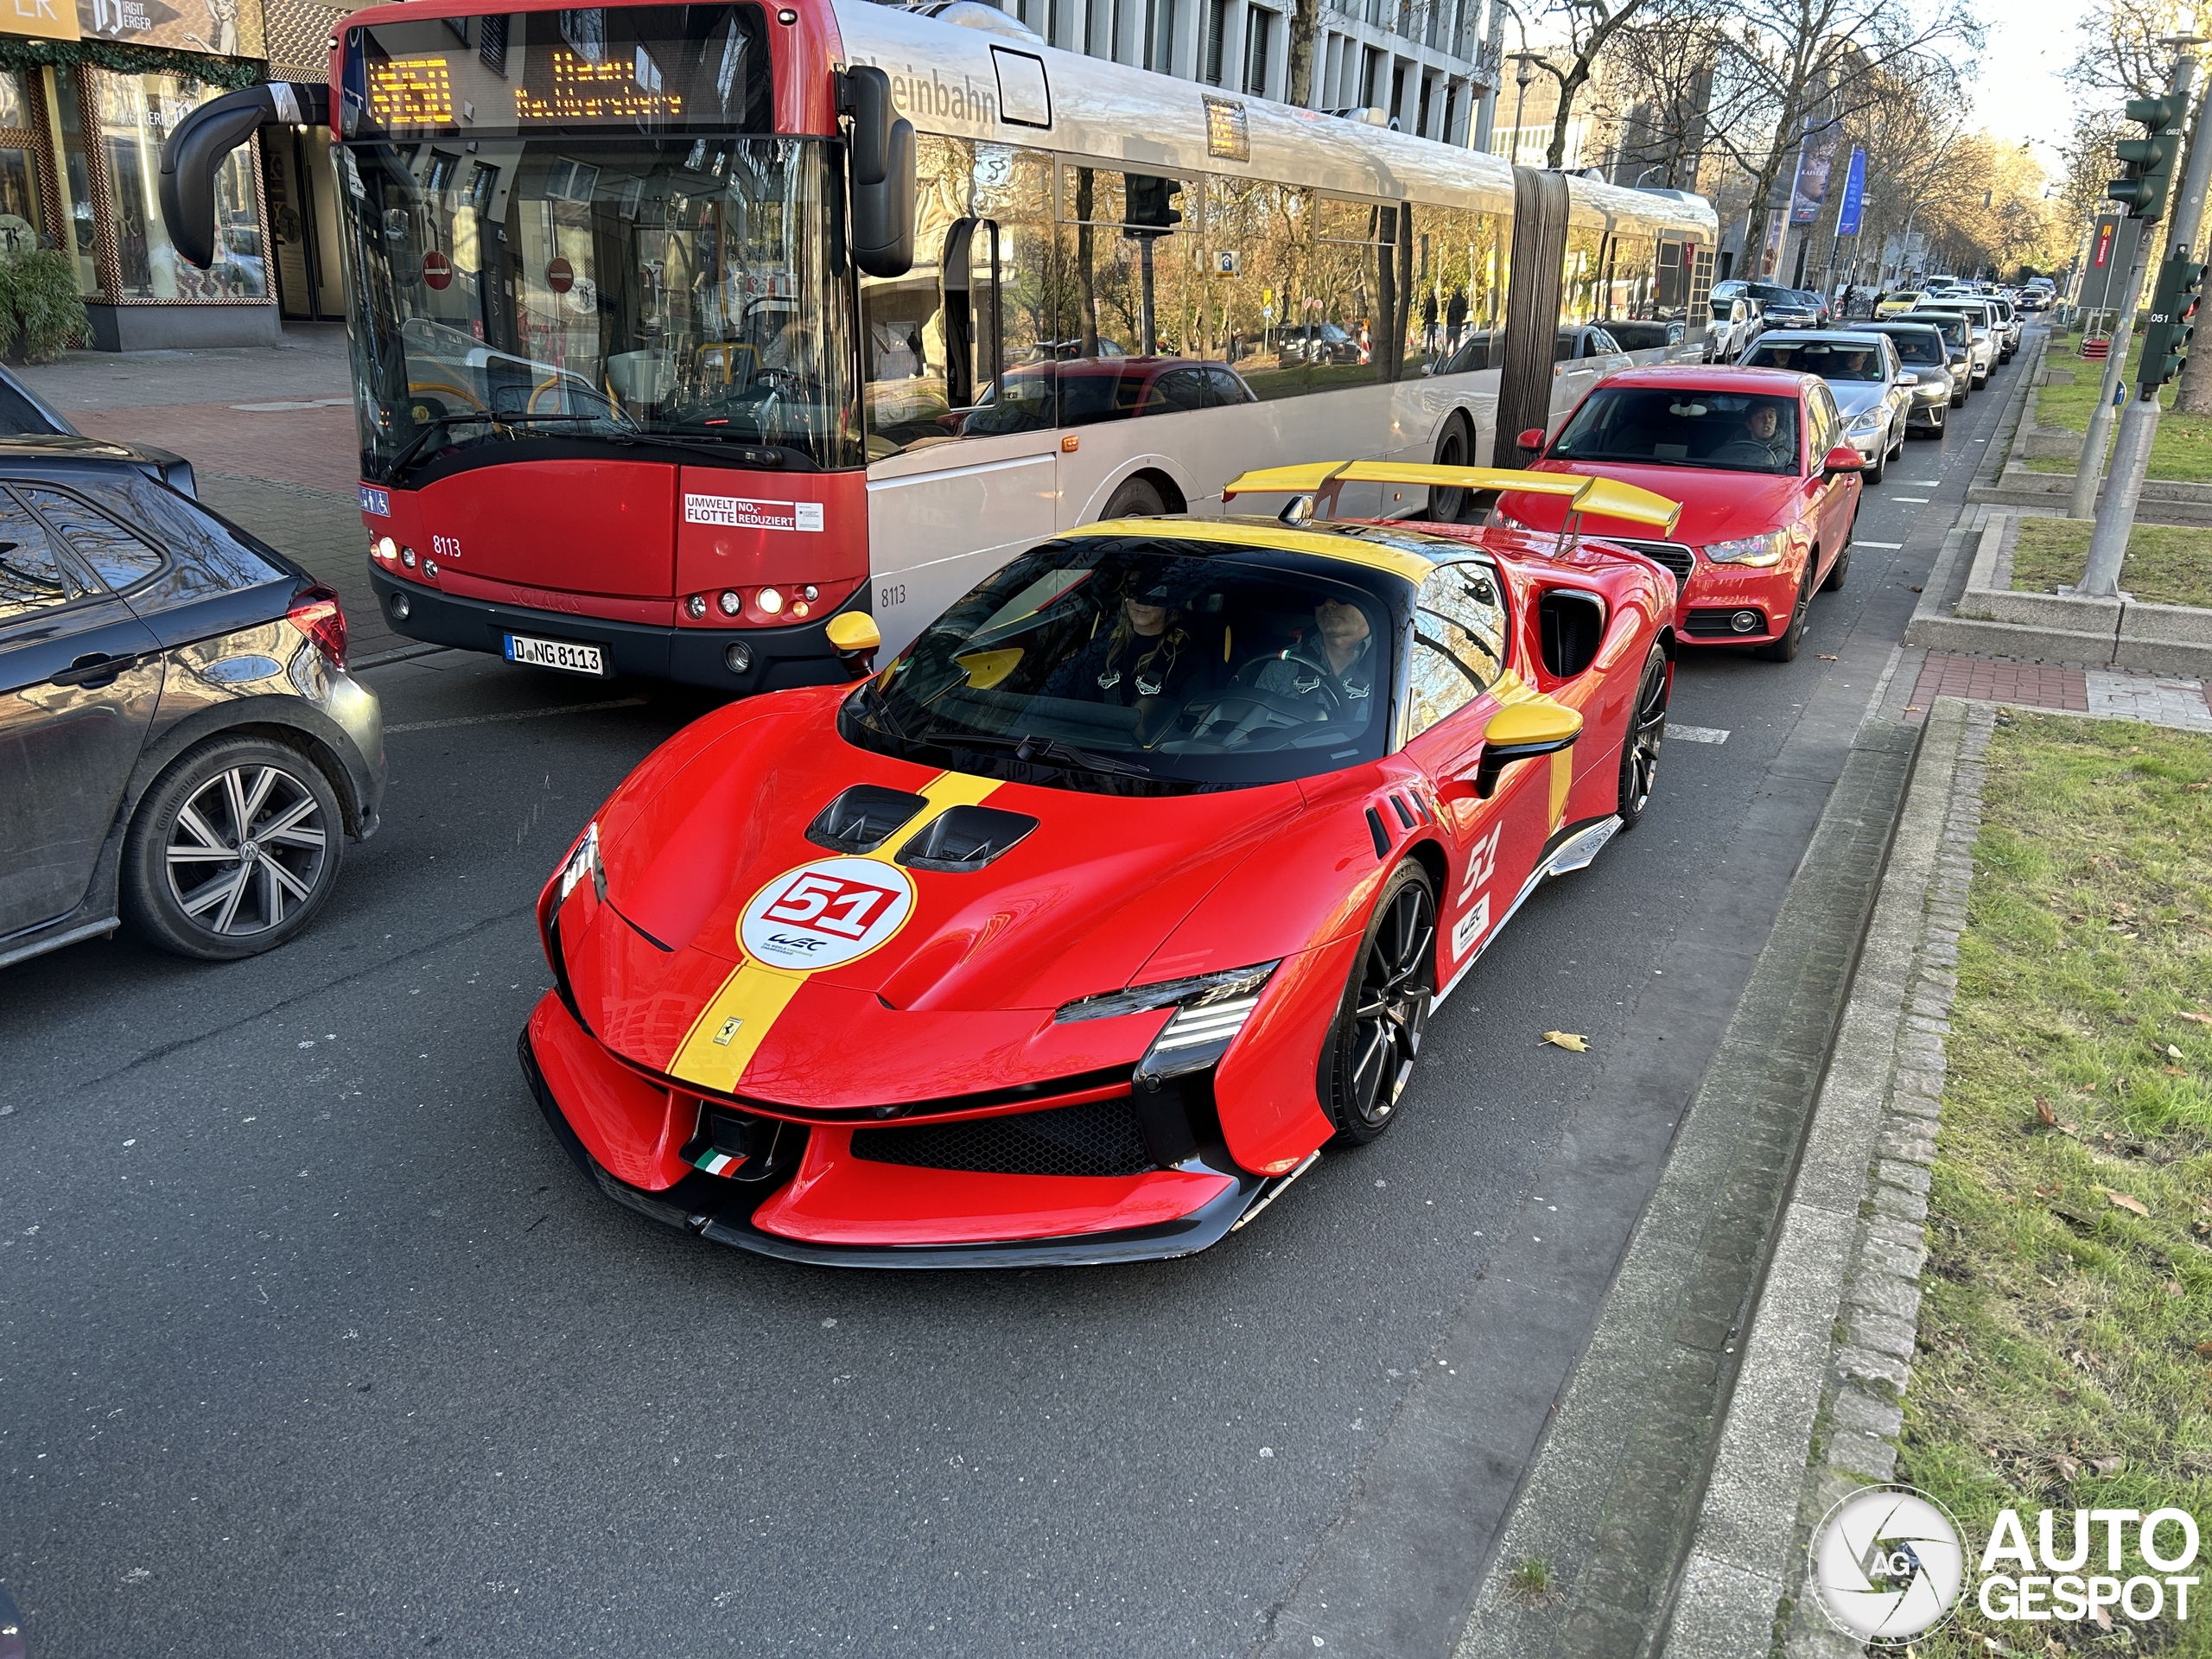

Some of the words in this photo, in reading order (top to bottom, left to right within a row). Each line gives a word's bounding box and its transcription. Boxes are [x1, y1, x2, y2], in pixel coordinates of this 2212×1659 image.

[851, 55, 996, 125] einbahn
[2151, 314, 2169, 323] 051
[687, 497, 734, 510] UMWELT
[687, 509, 735, 524] FLOTTE
[738, 515, 795, 527] REDUZIERT
[433, 535, 461, 557] 8113
[881, 584, 906, 607] 8113
[156, 772, 201, 831] Continental
[1457, 820, 1503, 909] 51
[767, 877, 884, 936] 51
[767, 934, 828, 951] WEC
